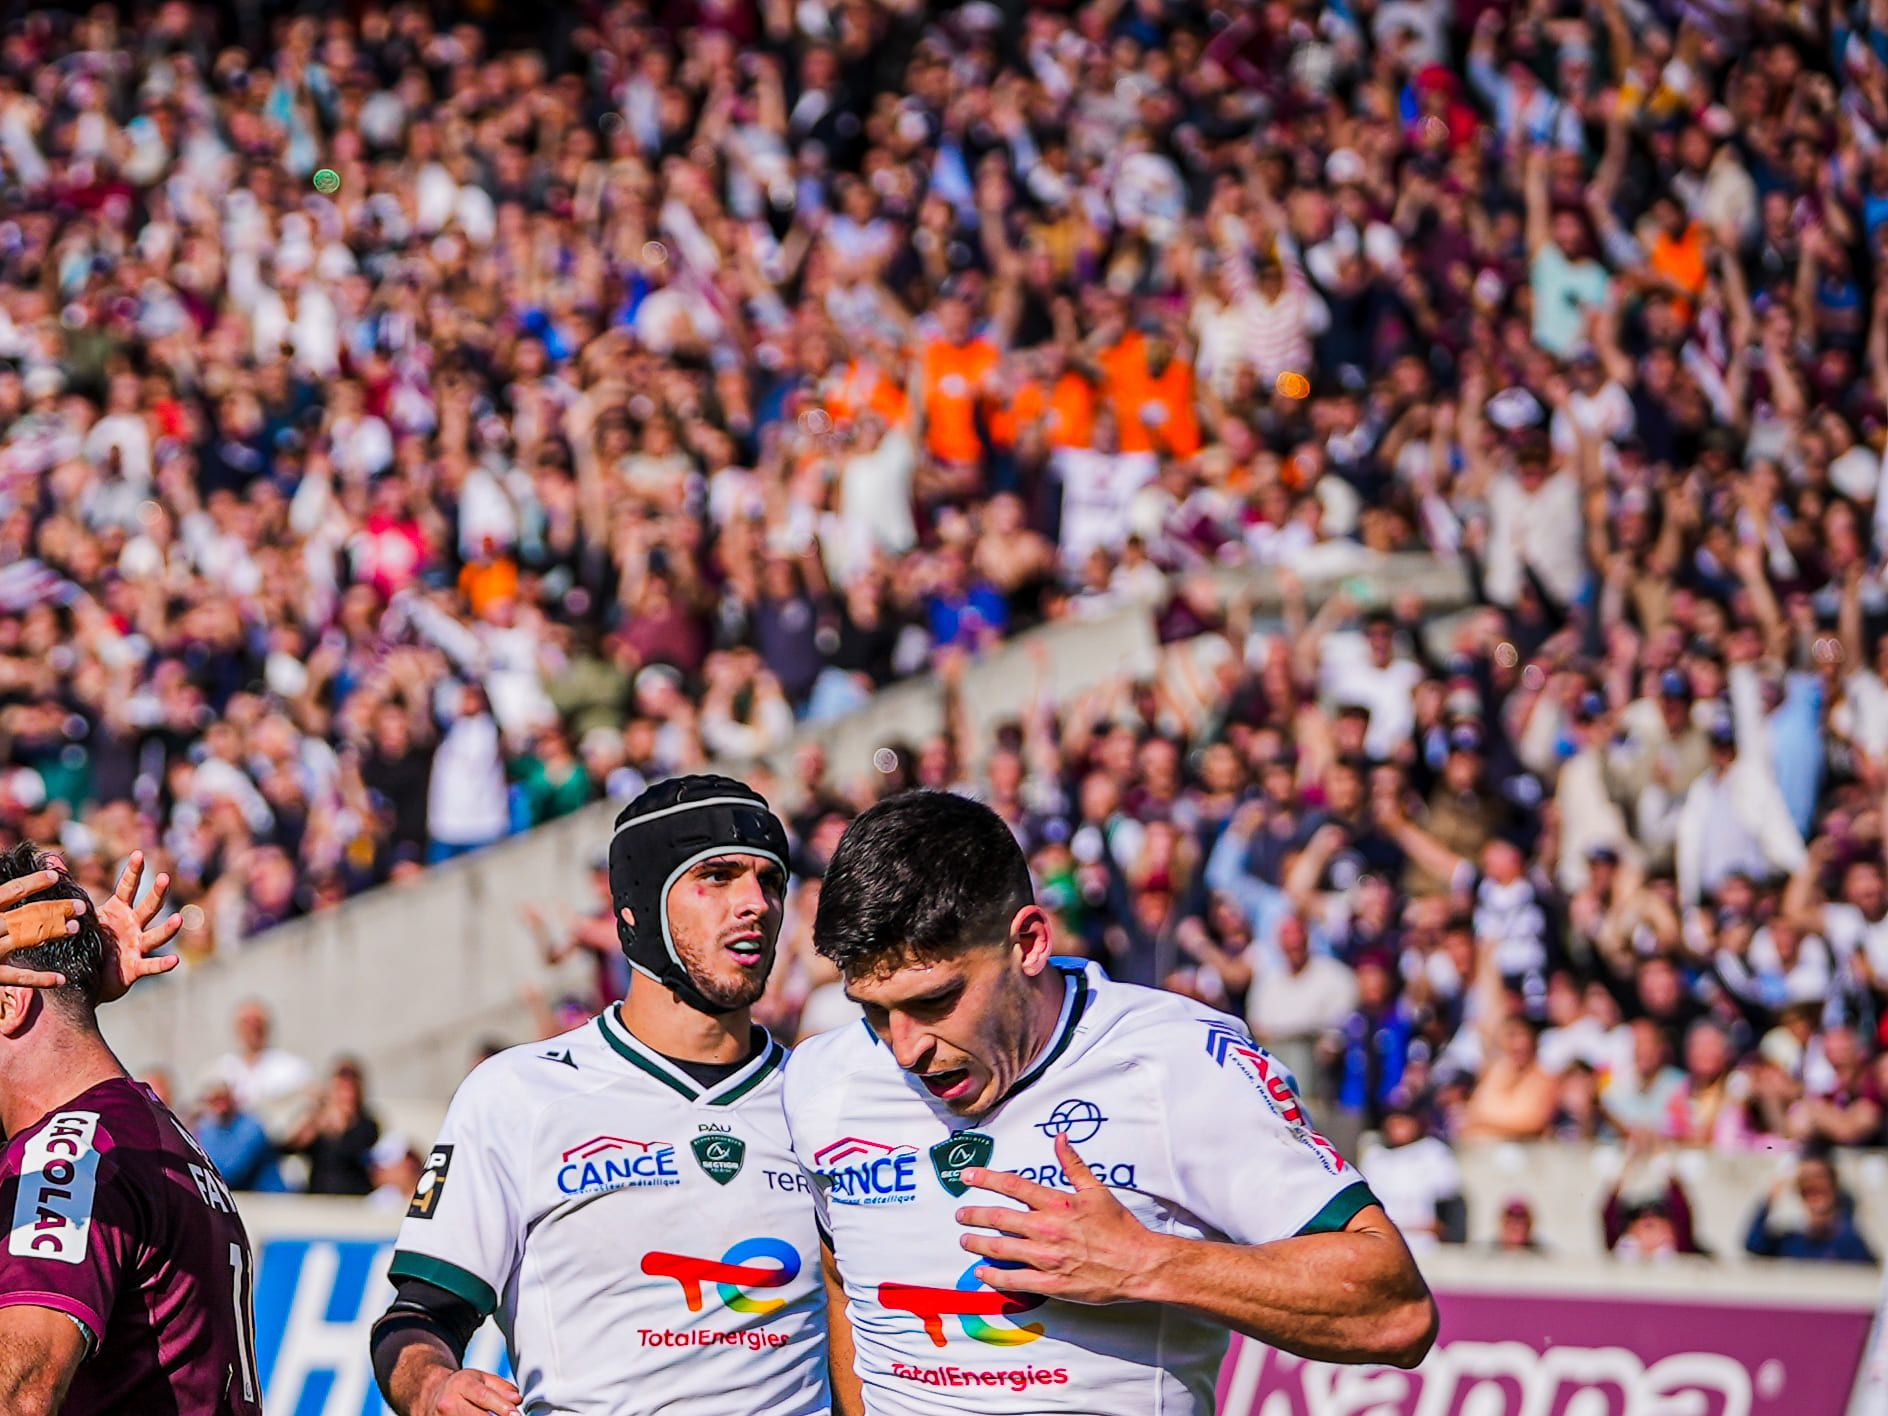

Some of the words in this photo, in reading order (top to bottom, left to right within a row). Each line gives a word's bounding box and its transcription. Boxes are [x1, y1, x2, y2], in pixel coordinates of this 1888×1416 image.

[698, 1123, 732, 1133] PAU
[31, 1117, 89, 1253] CACOLAC
[230, 1242, 262, 1408] 1
[637, 1328, 790, 1351] TotalEnergies
[891, 1363, 1069, 1392] TotalEnergies
